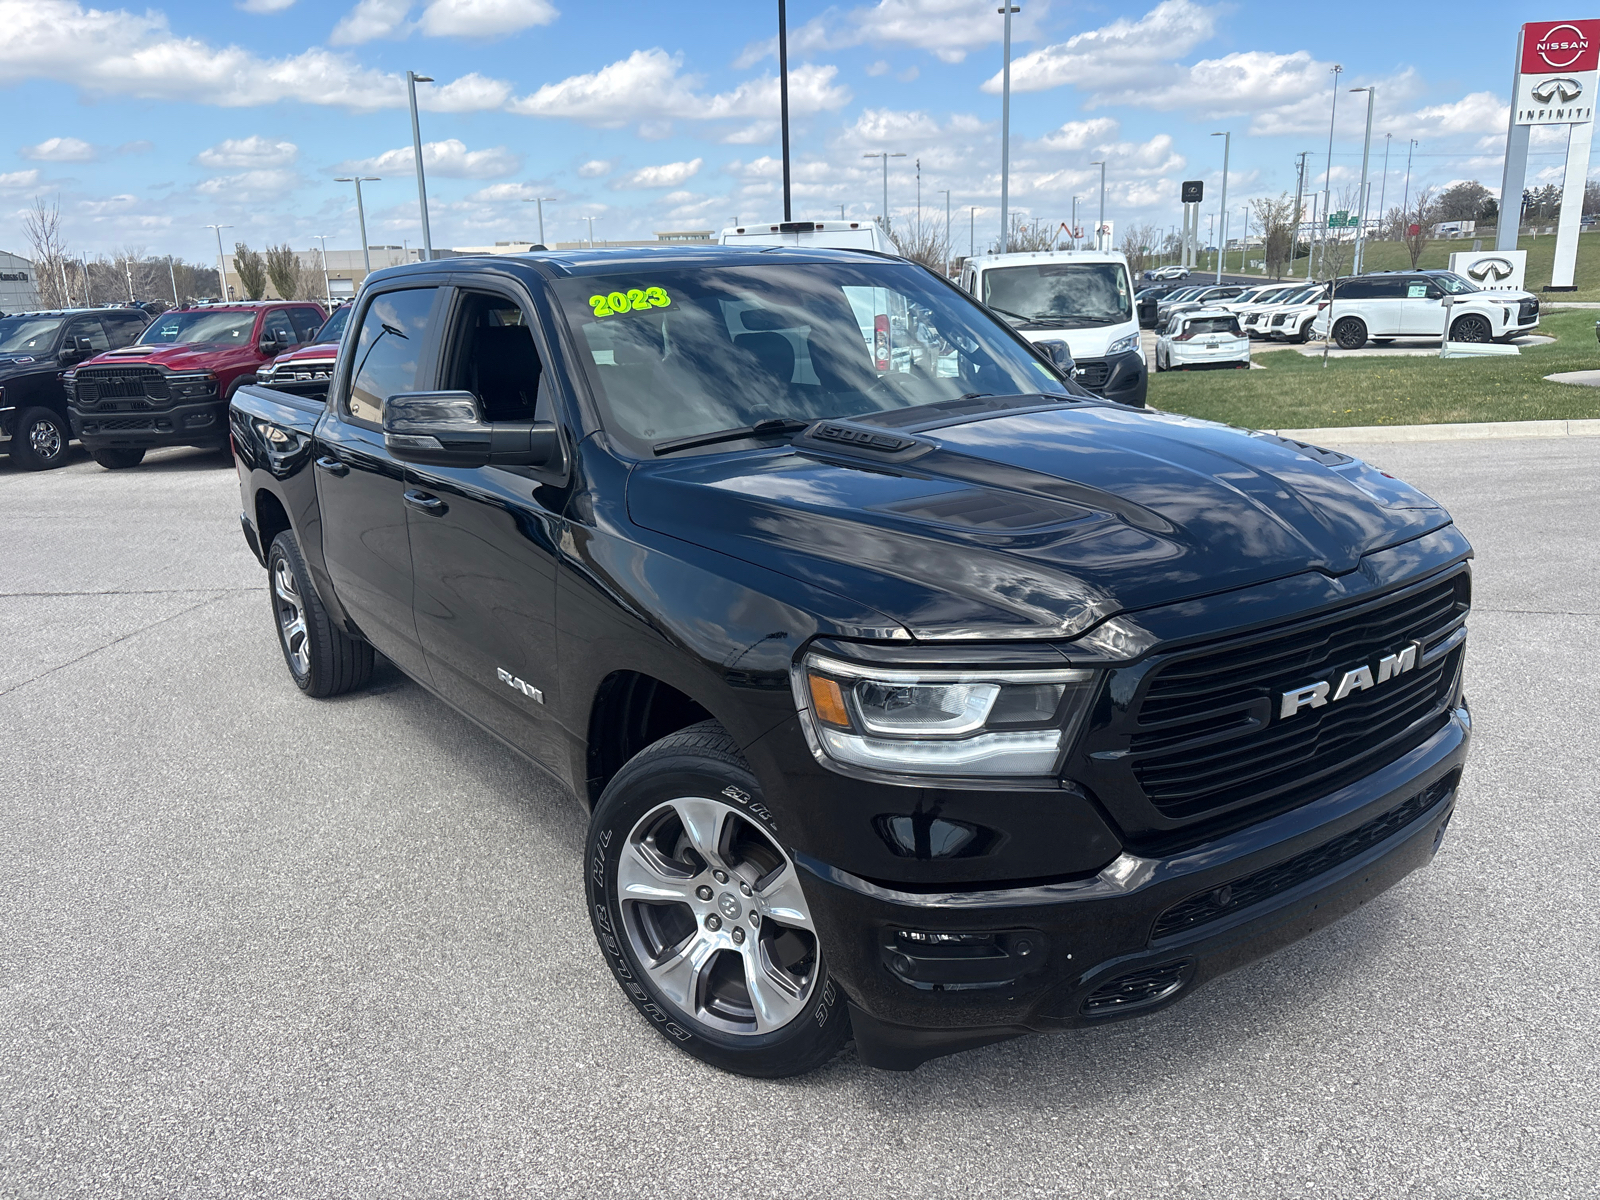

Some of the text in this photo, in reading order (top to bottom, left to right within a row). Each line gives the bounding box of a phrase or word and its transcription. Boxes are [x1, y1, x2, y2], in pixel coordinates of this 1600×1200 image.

[1536, 40, 1589, 51] NISSAN
[1518, 108, 1591, 121] INFINITI
[589, 286, 671, 317] 2023
[816, 423, 875, 444] 1500
[496, 666, 544, 705] RAM
[1279, 644, 1417, 720] RAM
[593, 829, 692, 1042] DUELER H/L
